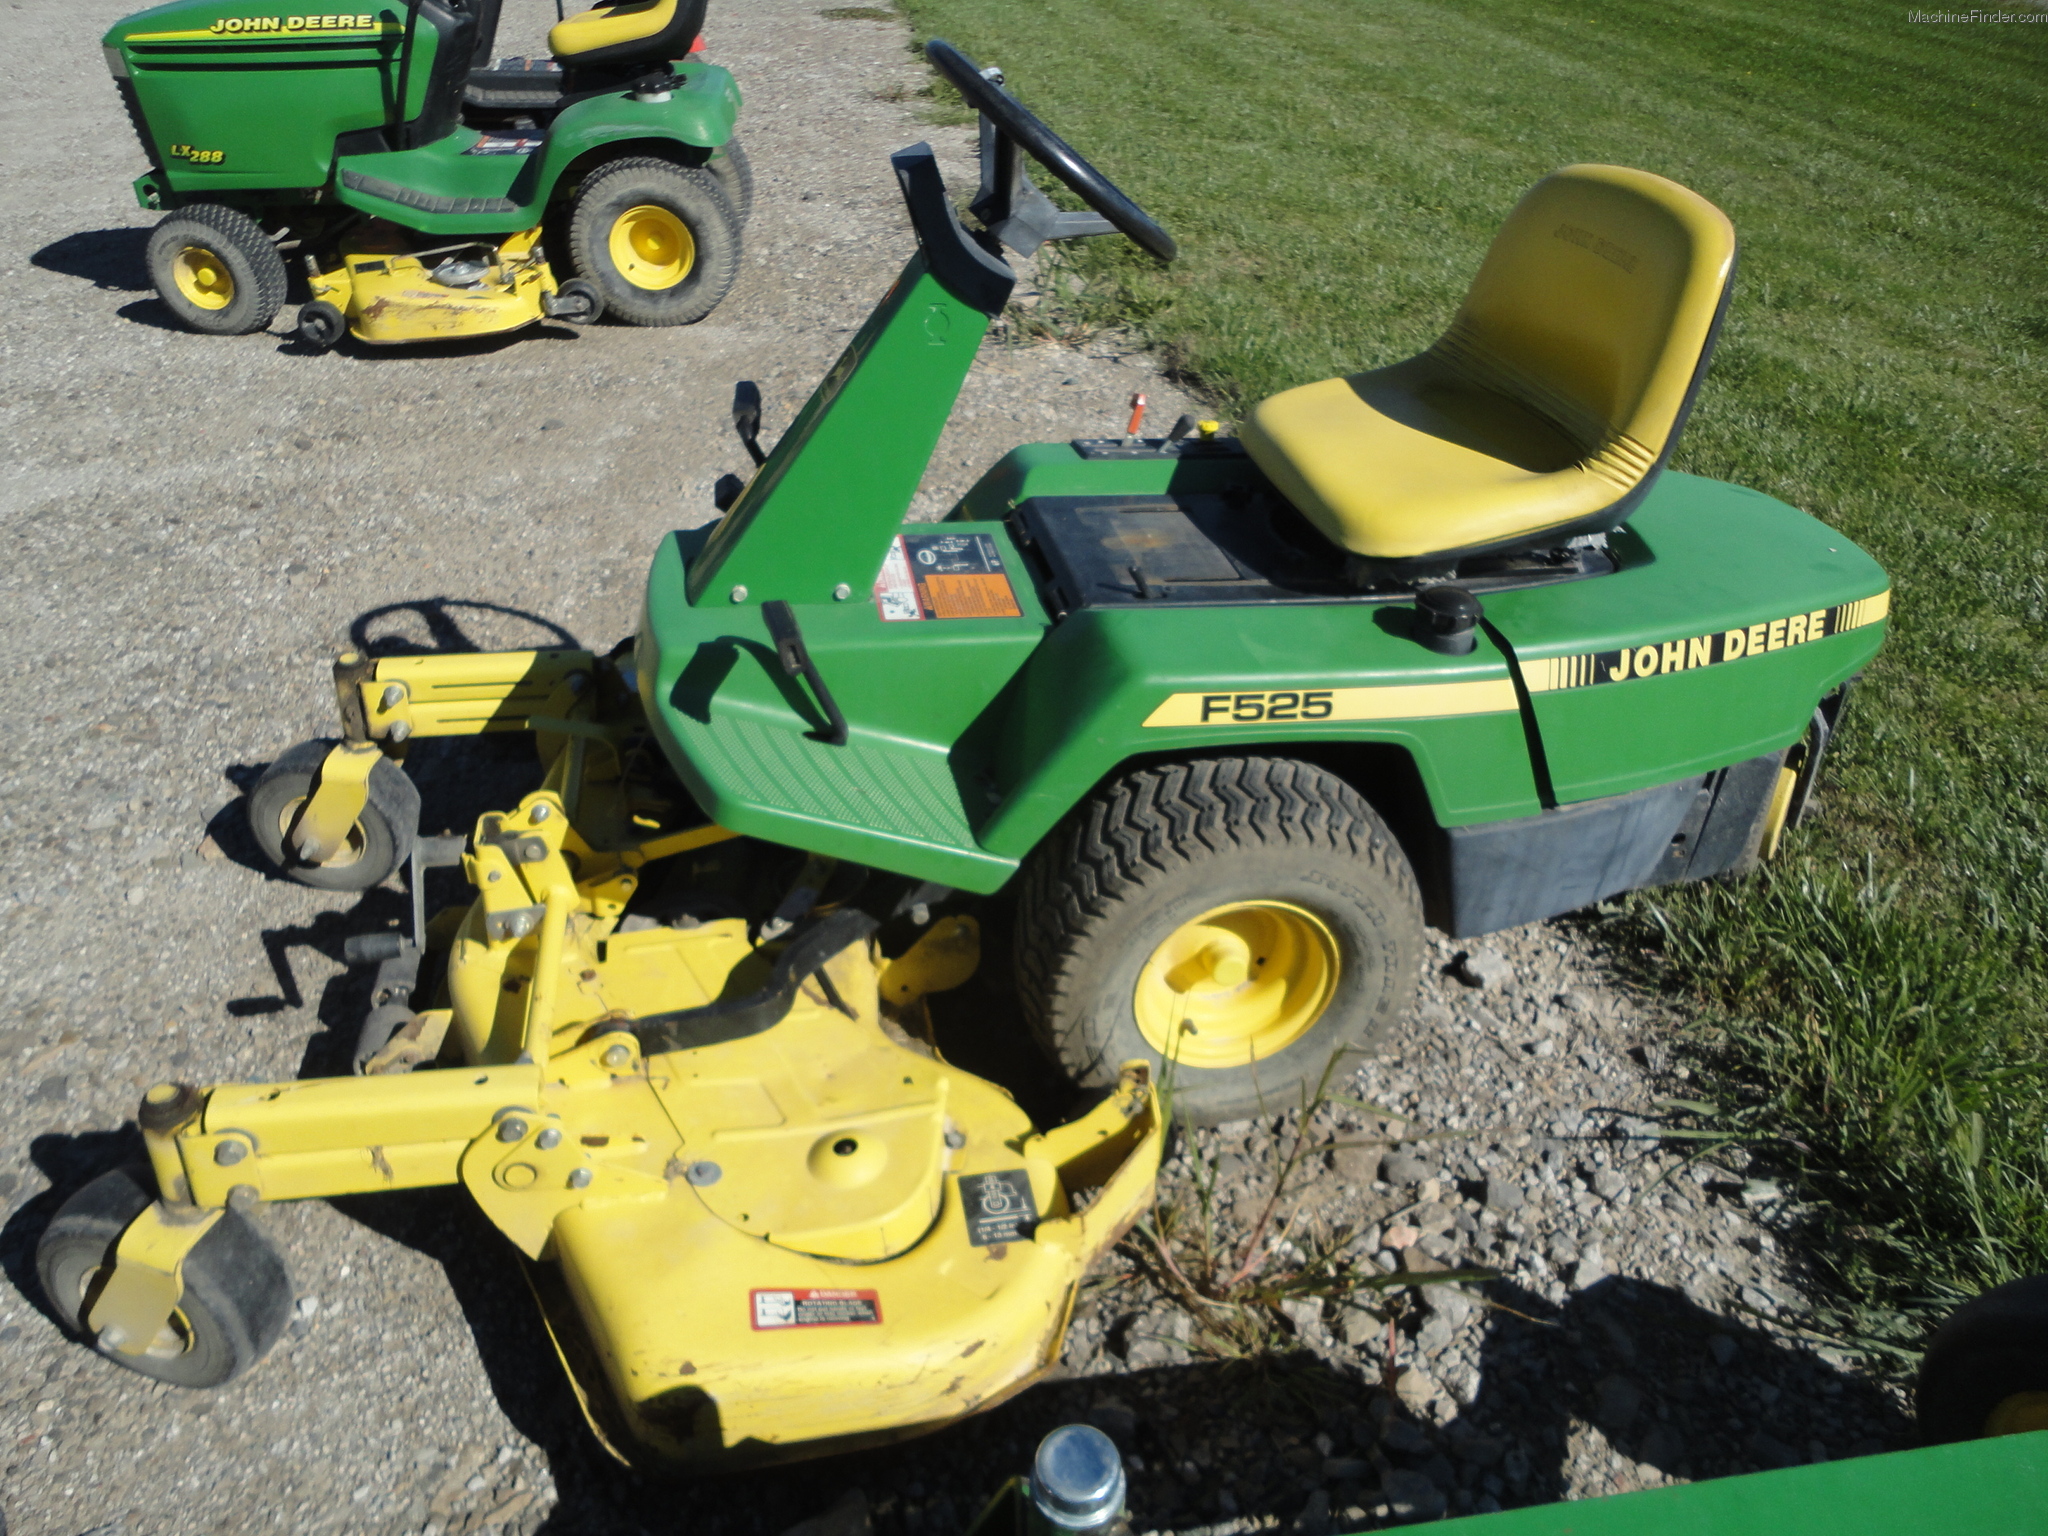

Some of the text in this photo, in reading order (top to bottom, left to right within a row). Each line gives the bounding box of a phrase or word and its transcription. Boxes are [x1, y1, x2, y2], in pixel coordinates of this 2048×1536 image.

[209, 14, 374, 34] JOHN DEERE
[1609, 609, 1827, 682] JOHN DEERE
[1200, 691, 1334, 723] F525
